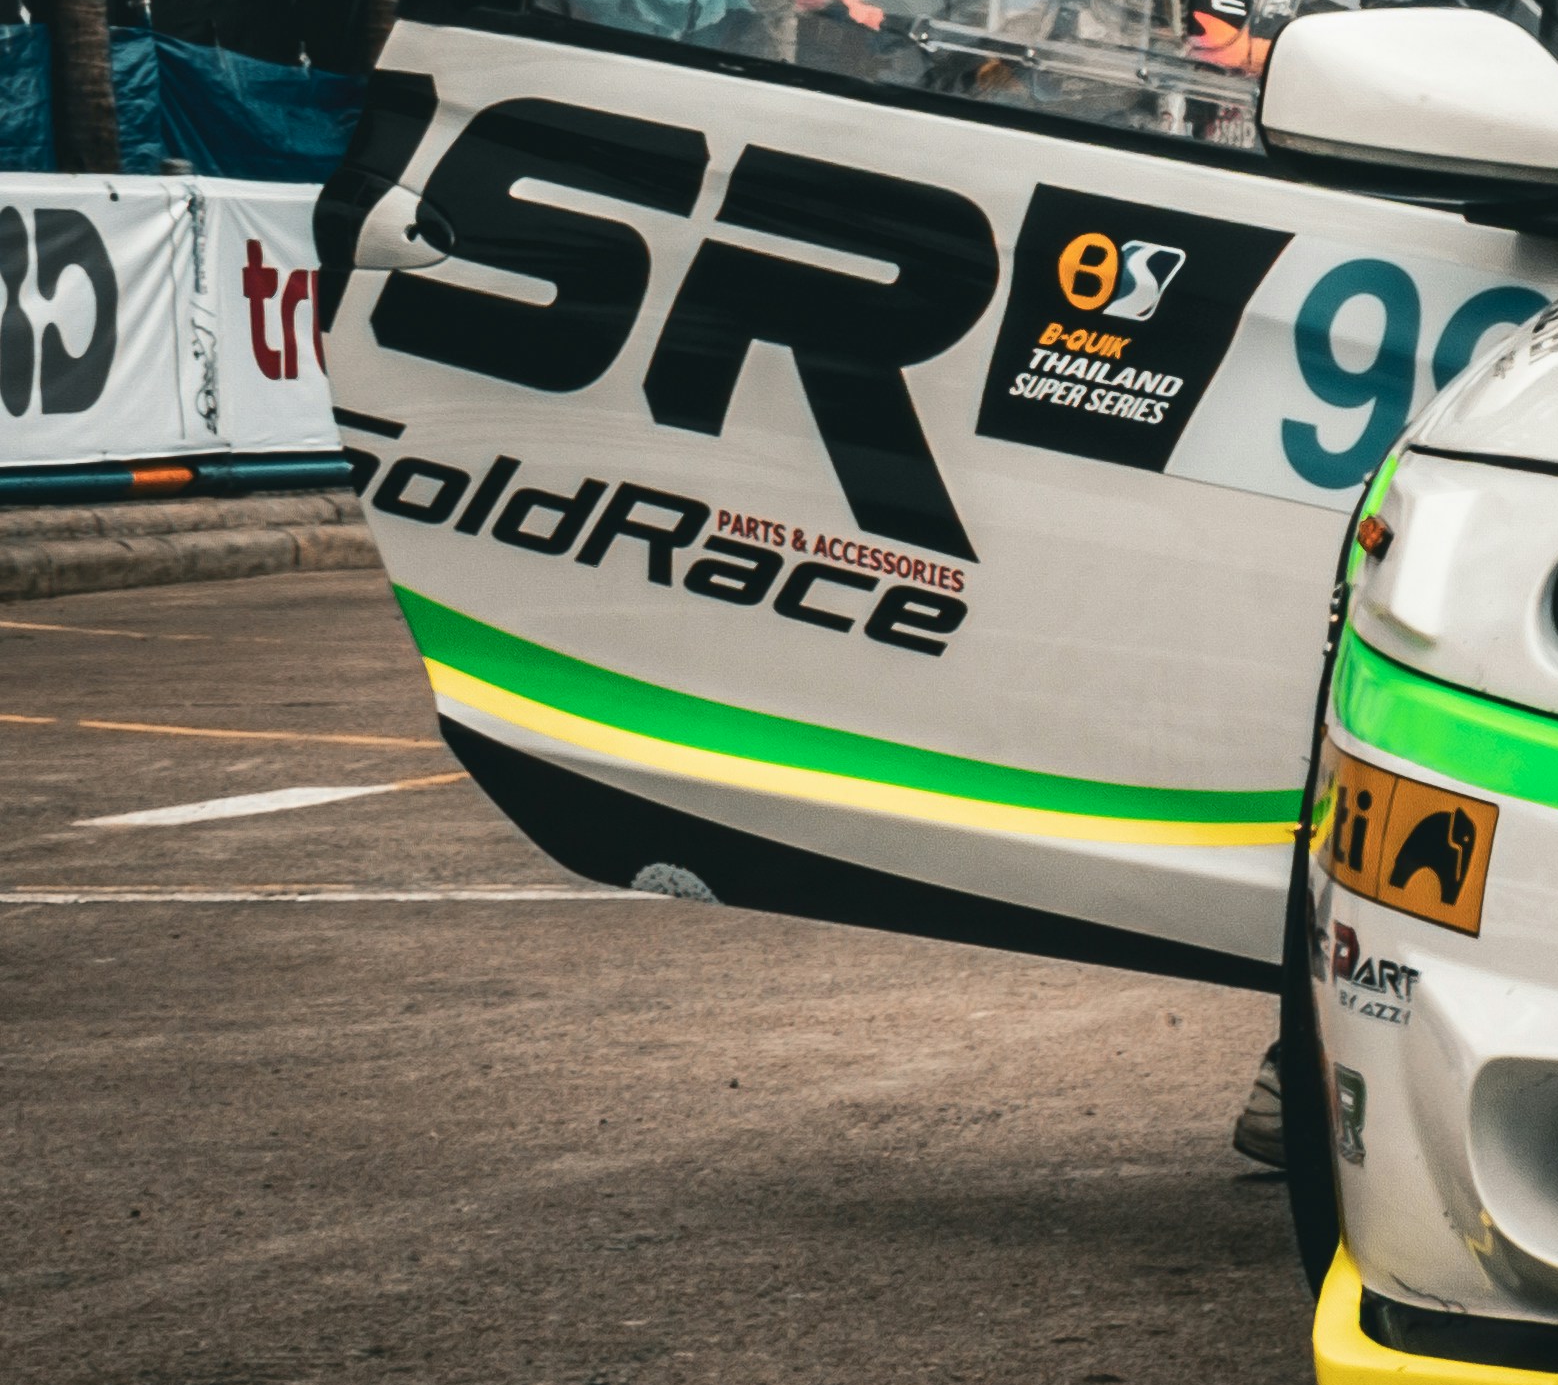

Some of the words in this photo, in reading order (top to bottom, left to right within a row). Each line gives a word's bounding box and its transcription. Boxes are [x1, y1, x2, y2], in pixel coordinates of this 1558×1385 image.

[1037, 322, 1132, 360] B-QUIK
[1009, 372, 1082, 408] SUPER
[1085, 390, 1170, 425] SERIES
[1028, 347, 1184, 399] THAILAND
[716, 509, 786, 549] PARTS
[791, 527, 808, 553] &
[813, 531, 966, 593] ACCESSORIES
